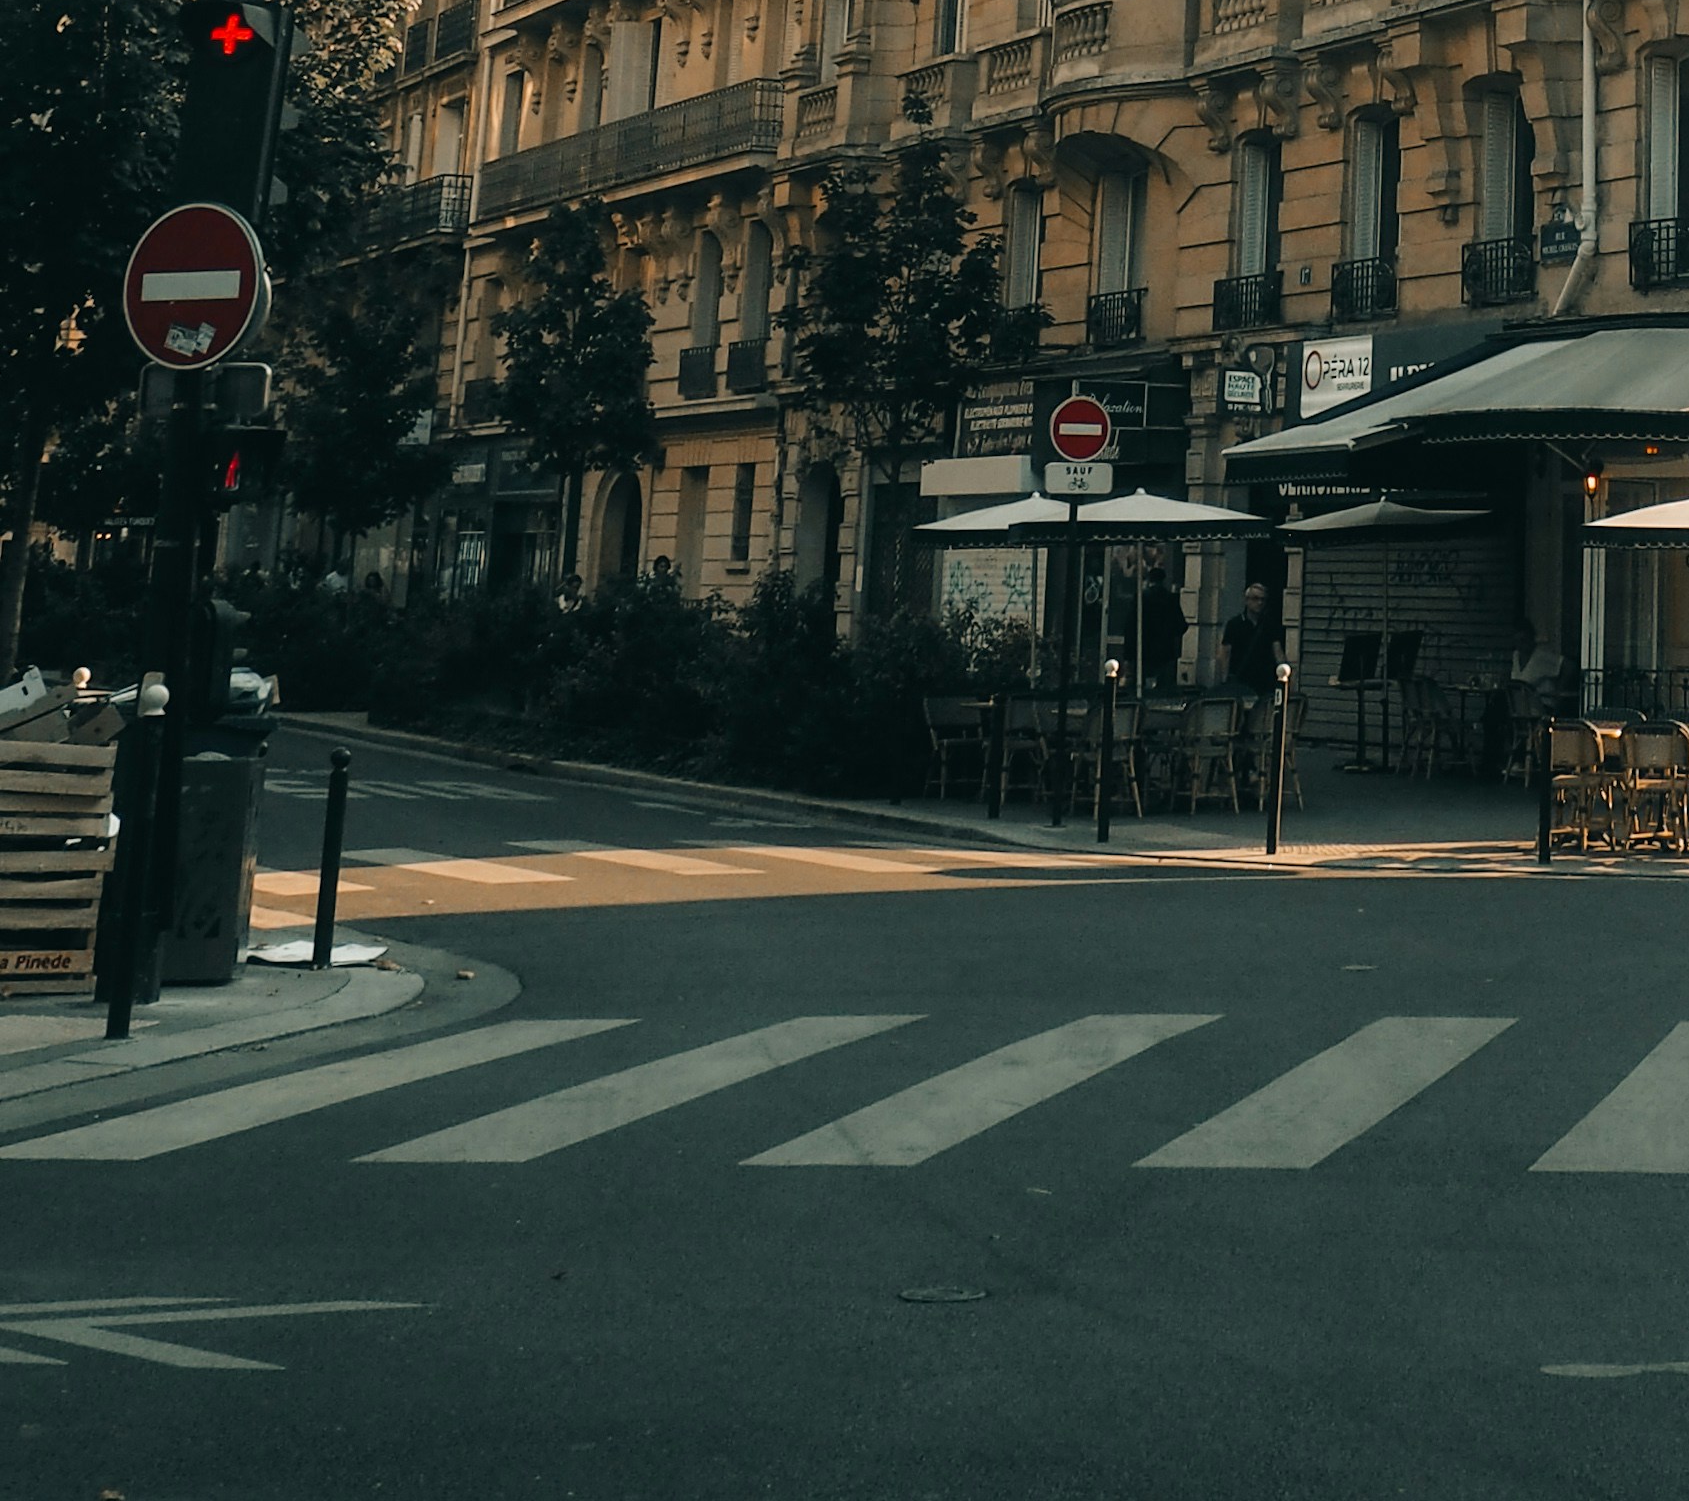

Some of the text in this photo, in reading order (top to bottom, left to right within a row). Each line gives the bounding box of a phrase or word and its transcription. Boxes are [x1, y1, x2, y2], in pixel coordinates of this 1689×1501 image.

[1305, 350, 1355, 390] OPÉRA
[1358, 357, 1369, 376] 12
[1066, 466, 1093, 475] SAUF
